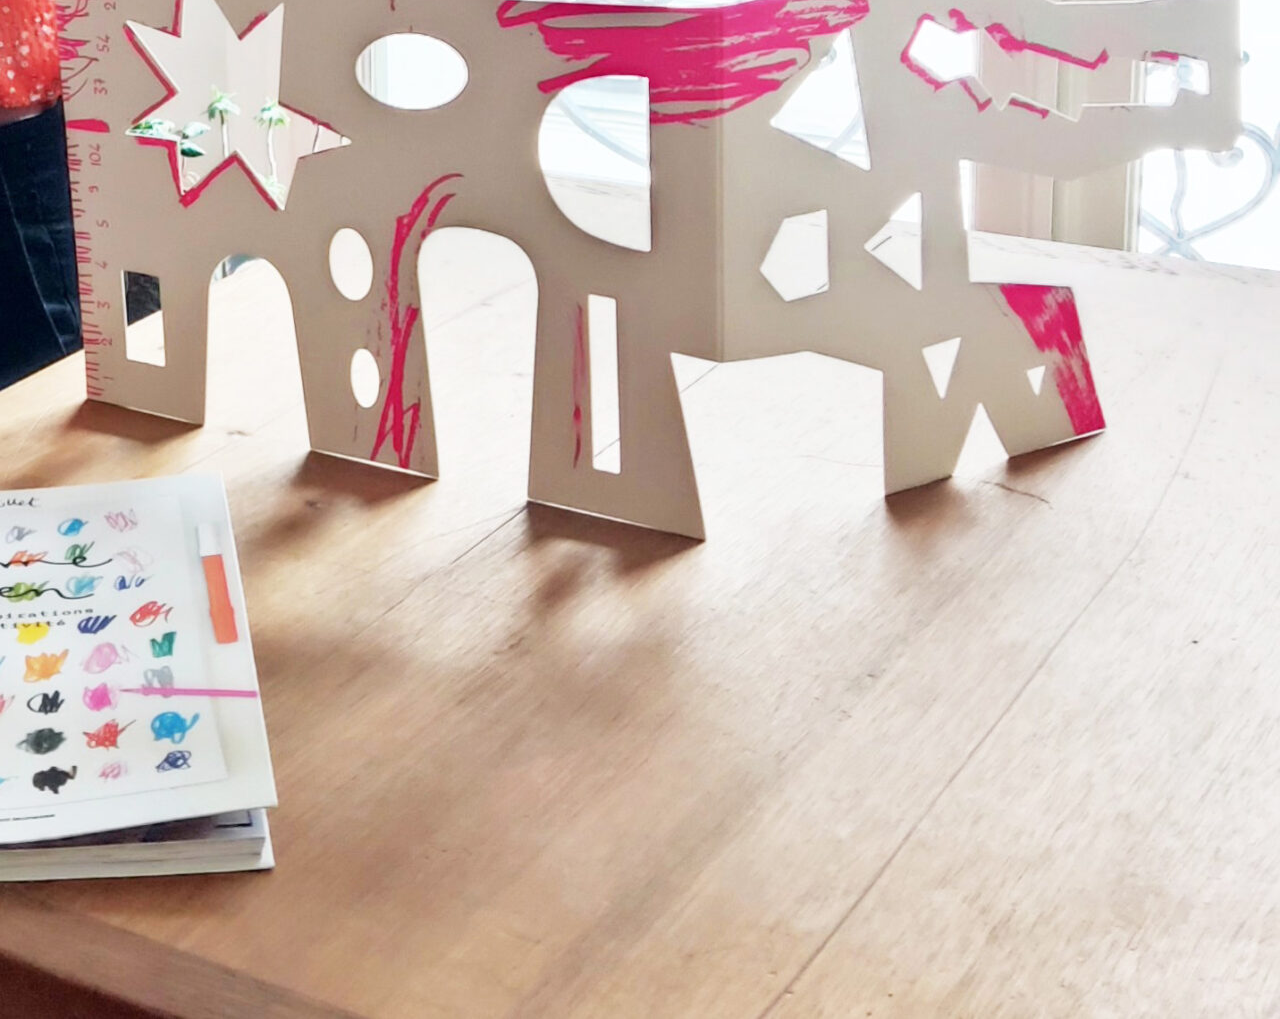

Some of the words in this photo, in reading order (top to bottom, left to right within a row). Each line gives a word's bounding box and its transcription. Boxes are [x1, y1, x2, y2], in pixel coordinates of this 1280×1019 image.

[97, 35, 111, 53] 54
[94, 78, 108, 95] 37
[96, 220, 110, 229] 5
[97, 300, 111, 309] 3
